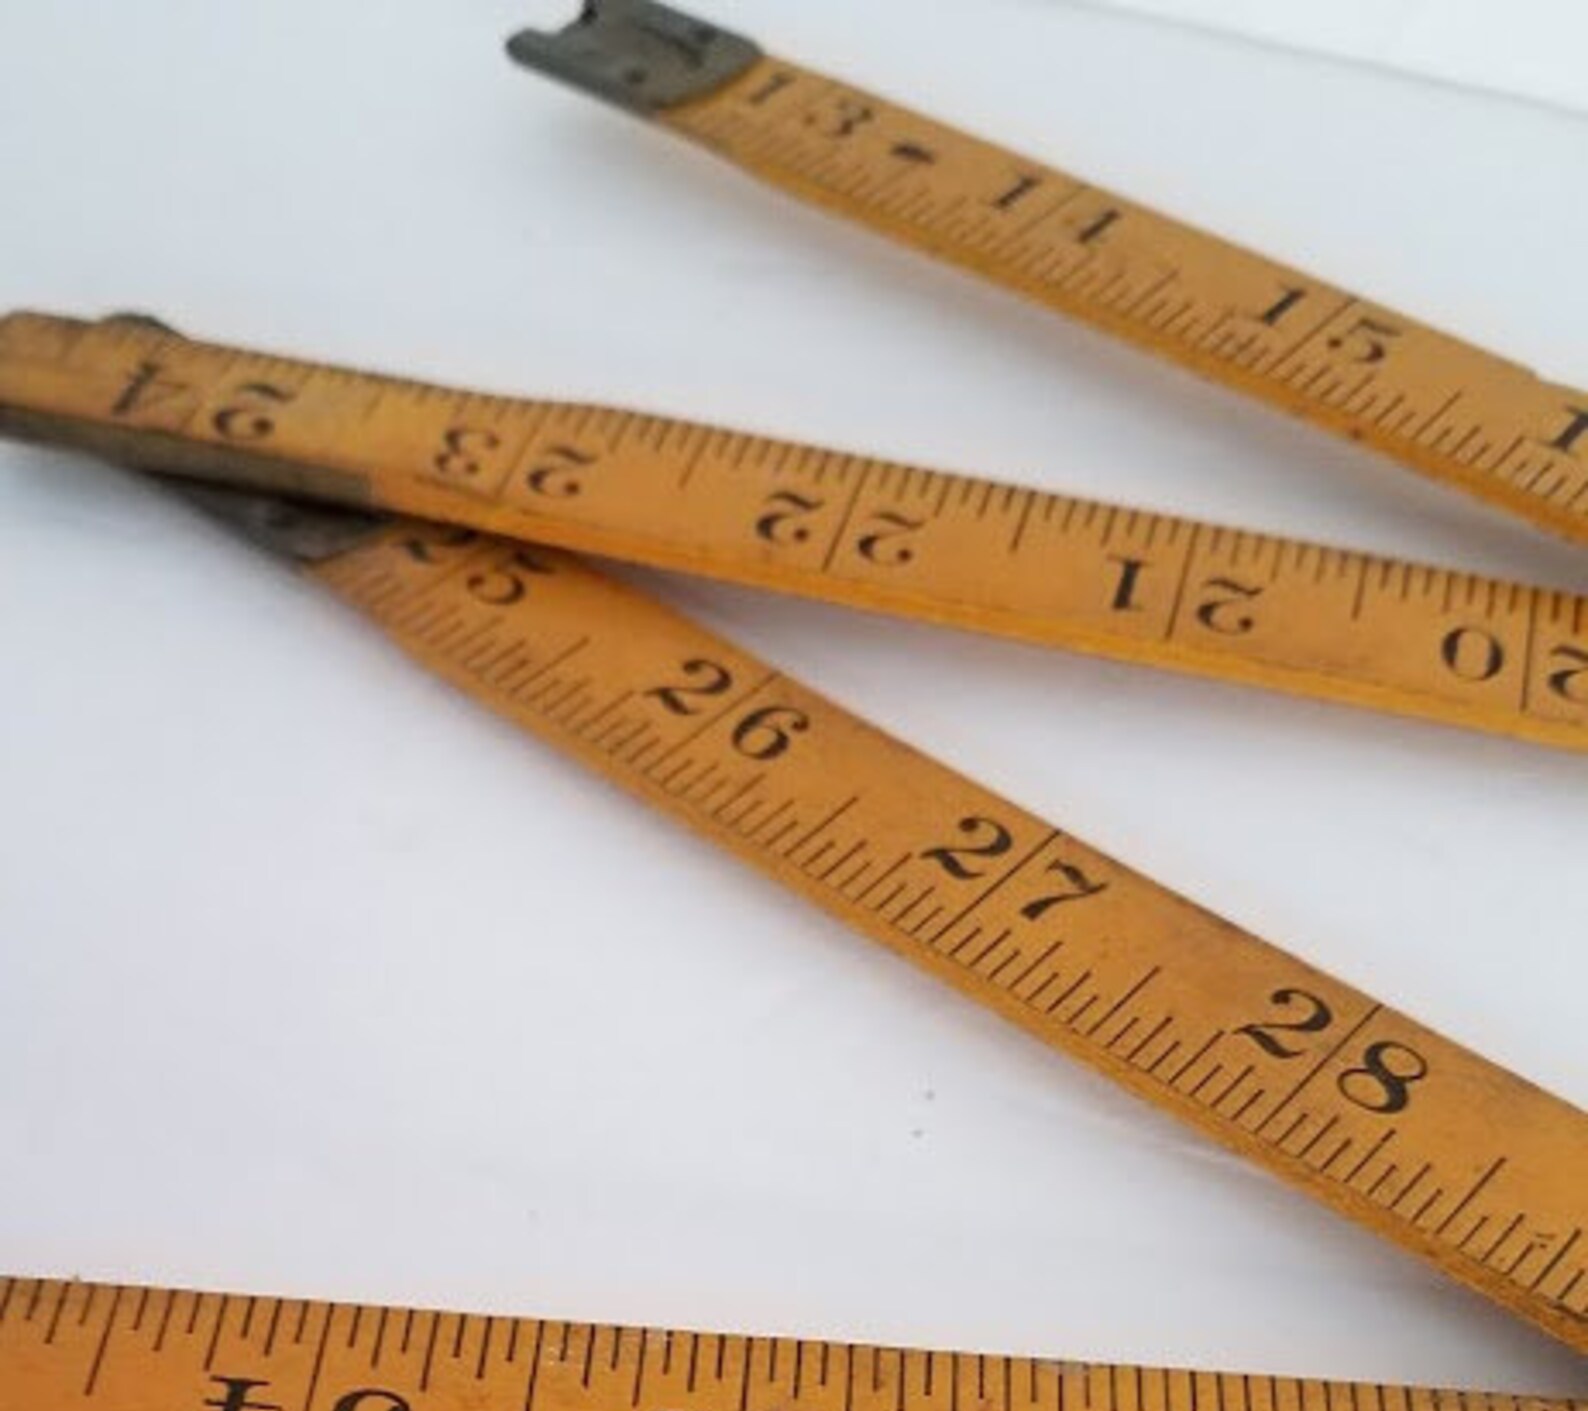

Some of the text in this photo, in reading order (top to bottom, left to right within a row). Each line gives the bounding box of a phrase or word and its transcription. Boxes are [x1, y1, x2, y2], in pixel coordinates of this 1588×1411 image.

[110, 360, 297, 441] 24
[433, 423, 599, 499] 23
[754, 488, 928, 568] 22
[1105, 552, 1264, 638] 21
[1250, 283, 1402, 366] 15
[1535, 403, 1588, 450] 1
[640, 656, 811, 762] 26
[920, 816, 1109, 922] 27
[1233, 987, 1429, 1116] 28
